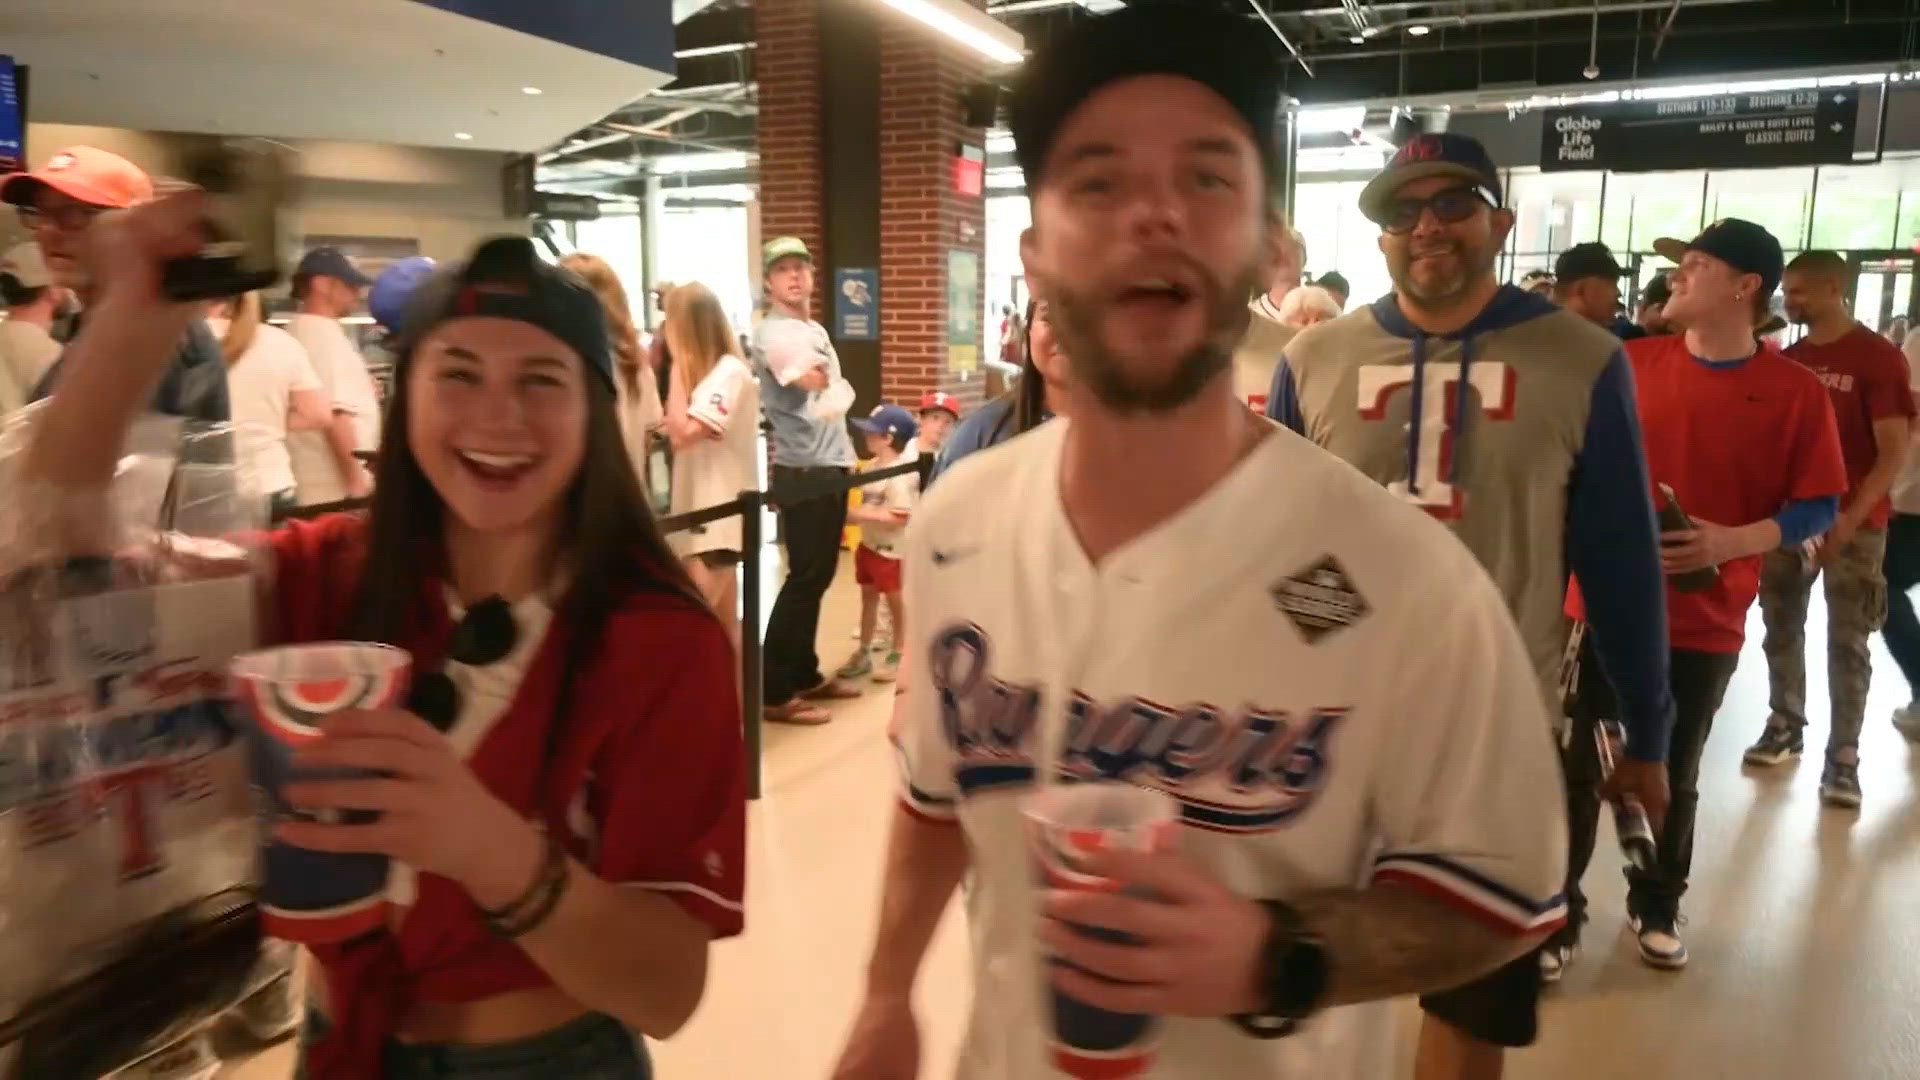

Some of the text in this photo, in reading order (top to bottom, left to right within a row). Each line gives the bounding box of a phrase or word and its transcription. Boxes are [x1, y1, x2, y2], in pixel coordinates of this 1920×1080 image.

[1656, 101, 1698, 115] SECTIONS
[1749, 94, 1793, 109] SECTIONS
[1555, 115, 1602, 132] Globe
[1767, 118, 1790, 129] SUITE
[1791, 116, 1815, 127] LEVEL
[1563, 130, 1592, 146] Life
[1745, 129, 1815, 144] CLASSIC SUITES
[1559, 144, 1594, 160] Field
[1358, 361, 1517, 521] T
